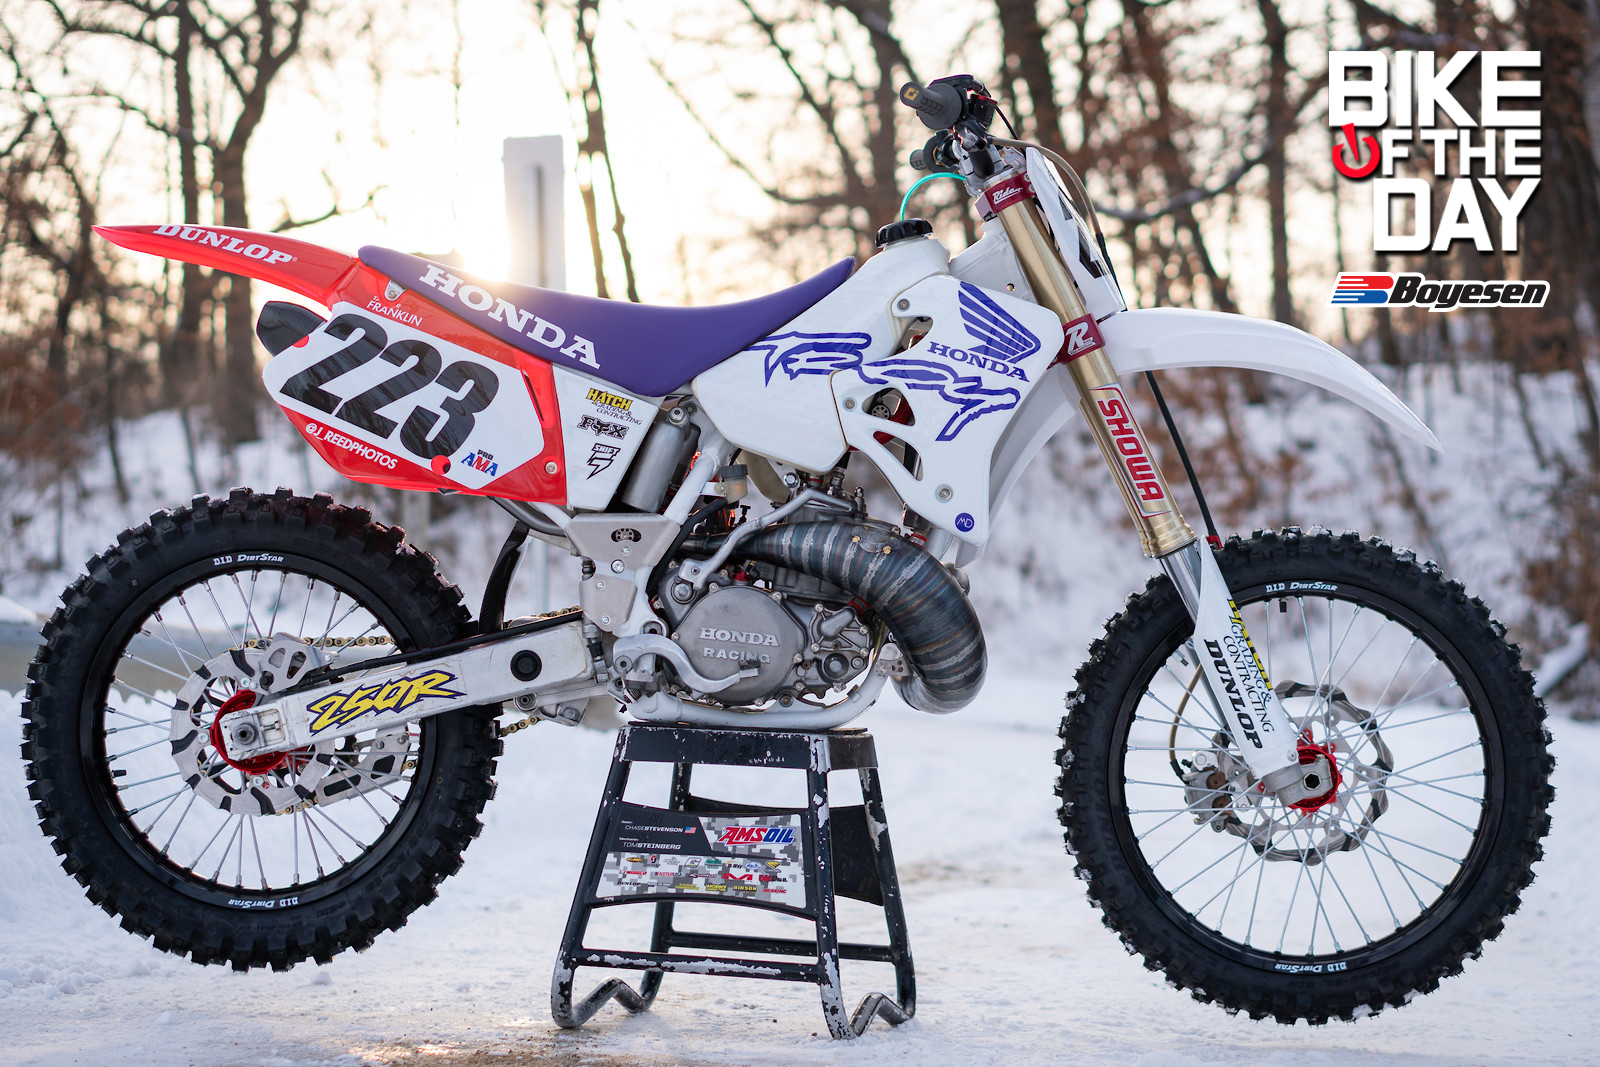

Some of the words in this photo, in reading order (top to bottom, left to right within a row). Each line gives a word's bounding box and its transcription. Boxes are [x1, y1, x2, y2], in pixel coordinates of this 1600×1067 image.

[153, 225, 292, 264] DUNLOP
[366, 300, 423, 327] FRANKLIN
[419, 264, 600, 369] HONDA
[927, 341, 1030, 383] HONDA
[280, 314, 499, 459] 223
[586, 388, 633, 411] HATCH
[595, 401, 627, 415] GRADING
[597, 408, 642, 425] CONTRACTING
[577, 414, 629, 440] FOX
[305, 423, 398, 470] @J_REEDPHOTOS
[477, 449, 493, 460] PRO
[592, 443, 621, 455] SHIFT
[1097, 398, 1165, 501] SHOWA
[461, 452, 499, 477] AMA
[699, 627, 780, 647] HONDA
[703, 647, 771, 664] RACING
[1230, 623, 1268, 690] GRADING
[1260, 690, 1272, 710] &
[1204, 639, 1263, 749] DUNLOP
[1223, 635, 1275, 733] CONTRACTING
[306, 669, 468, 737] 250R
[718, 826, 794, 845] AMSOIL
